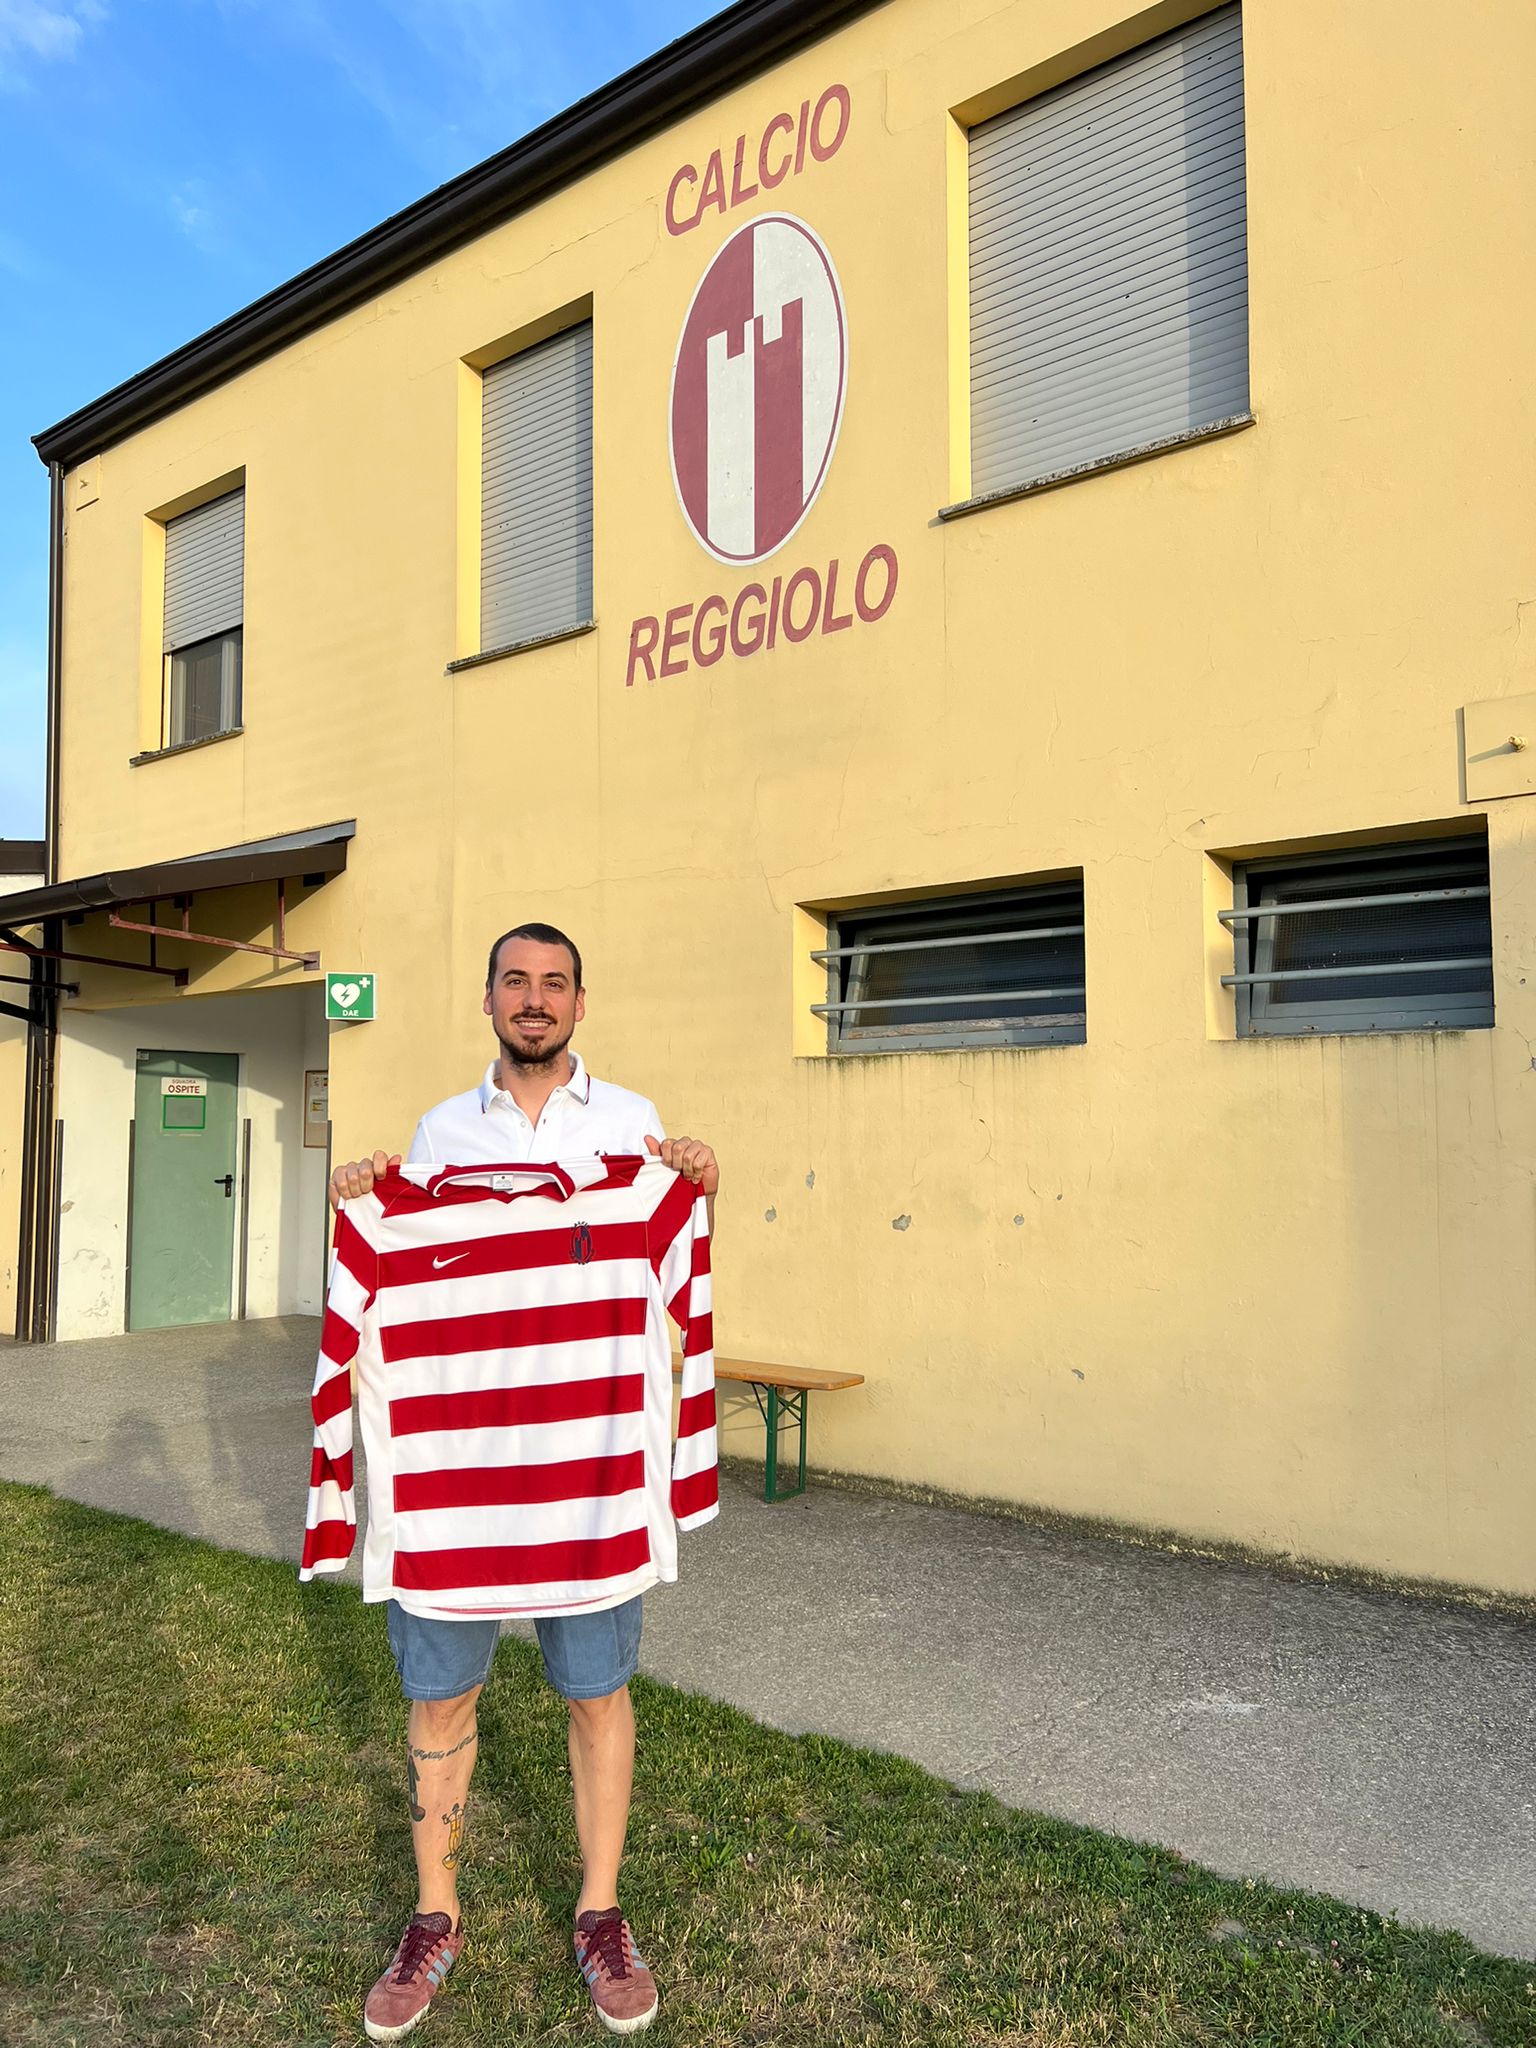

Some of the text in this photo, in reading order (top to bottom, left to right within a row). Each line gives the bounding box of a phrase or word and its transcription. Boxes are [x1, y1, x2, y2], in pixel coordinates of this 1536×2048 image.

[666, 84, 850, 236] CALCIO
[626, 543, 899, 687] REGGIOLO
[168, 1085, 200, 1093] OSPITE
